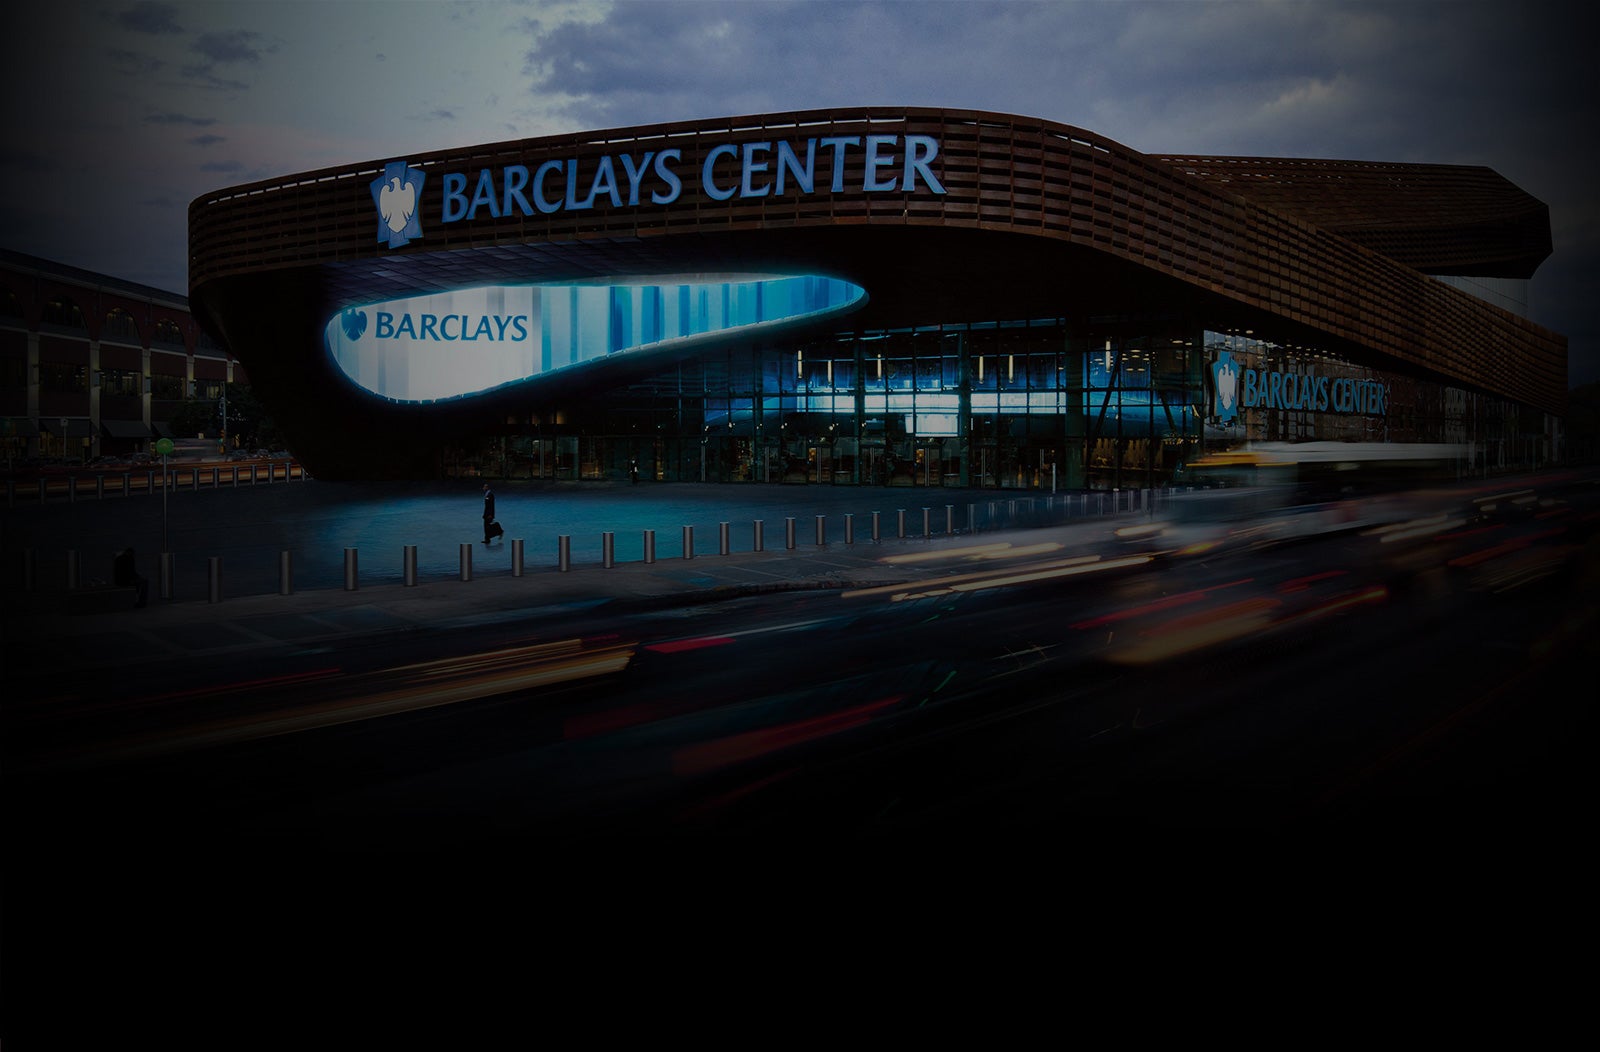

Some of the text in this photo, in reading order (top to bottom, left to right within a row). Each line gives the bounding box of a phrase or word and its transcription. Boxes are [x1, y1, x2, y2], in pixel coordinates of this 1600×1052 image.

[441, 134, 947, 224] BARCLAYS CENTER
[375, 311, 528, 342] BARCLAYS
[1244, 369, 1386, 415] BARCLAYS CENTER
